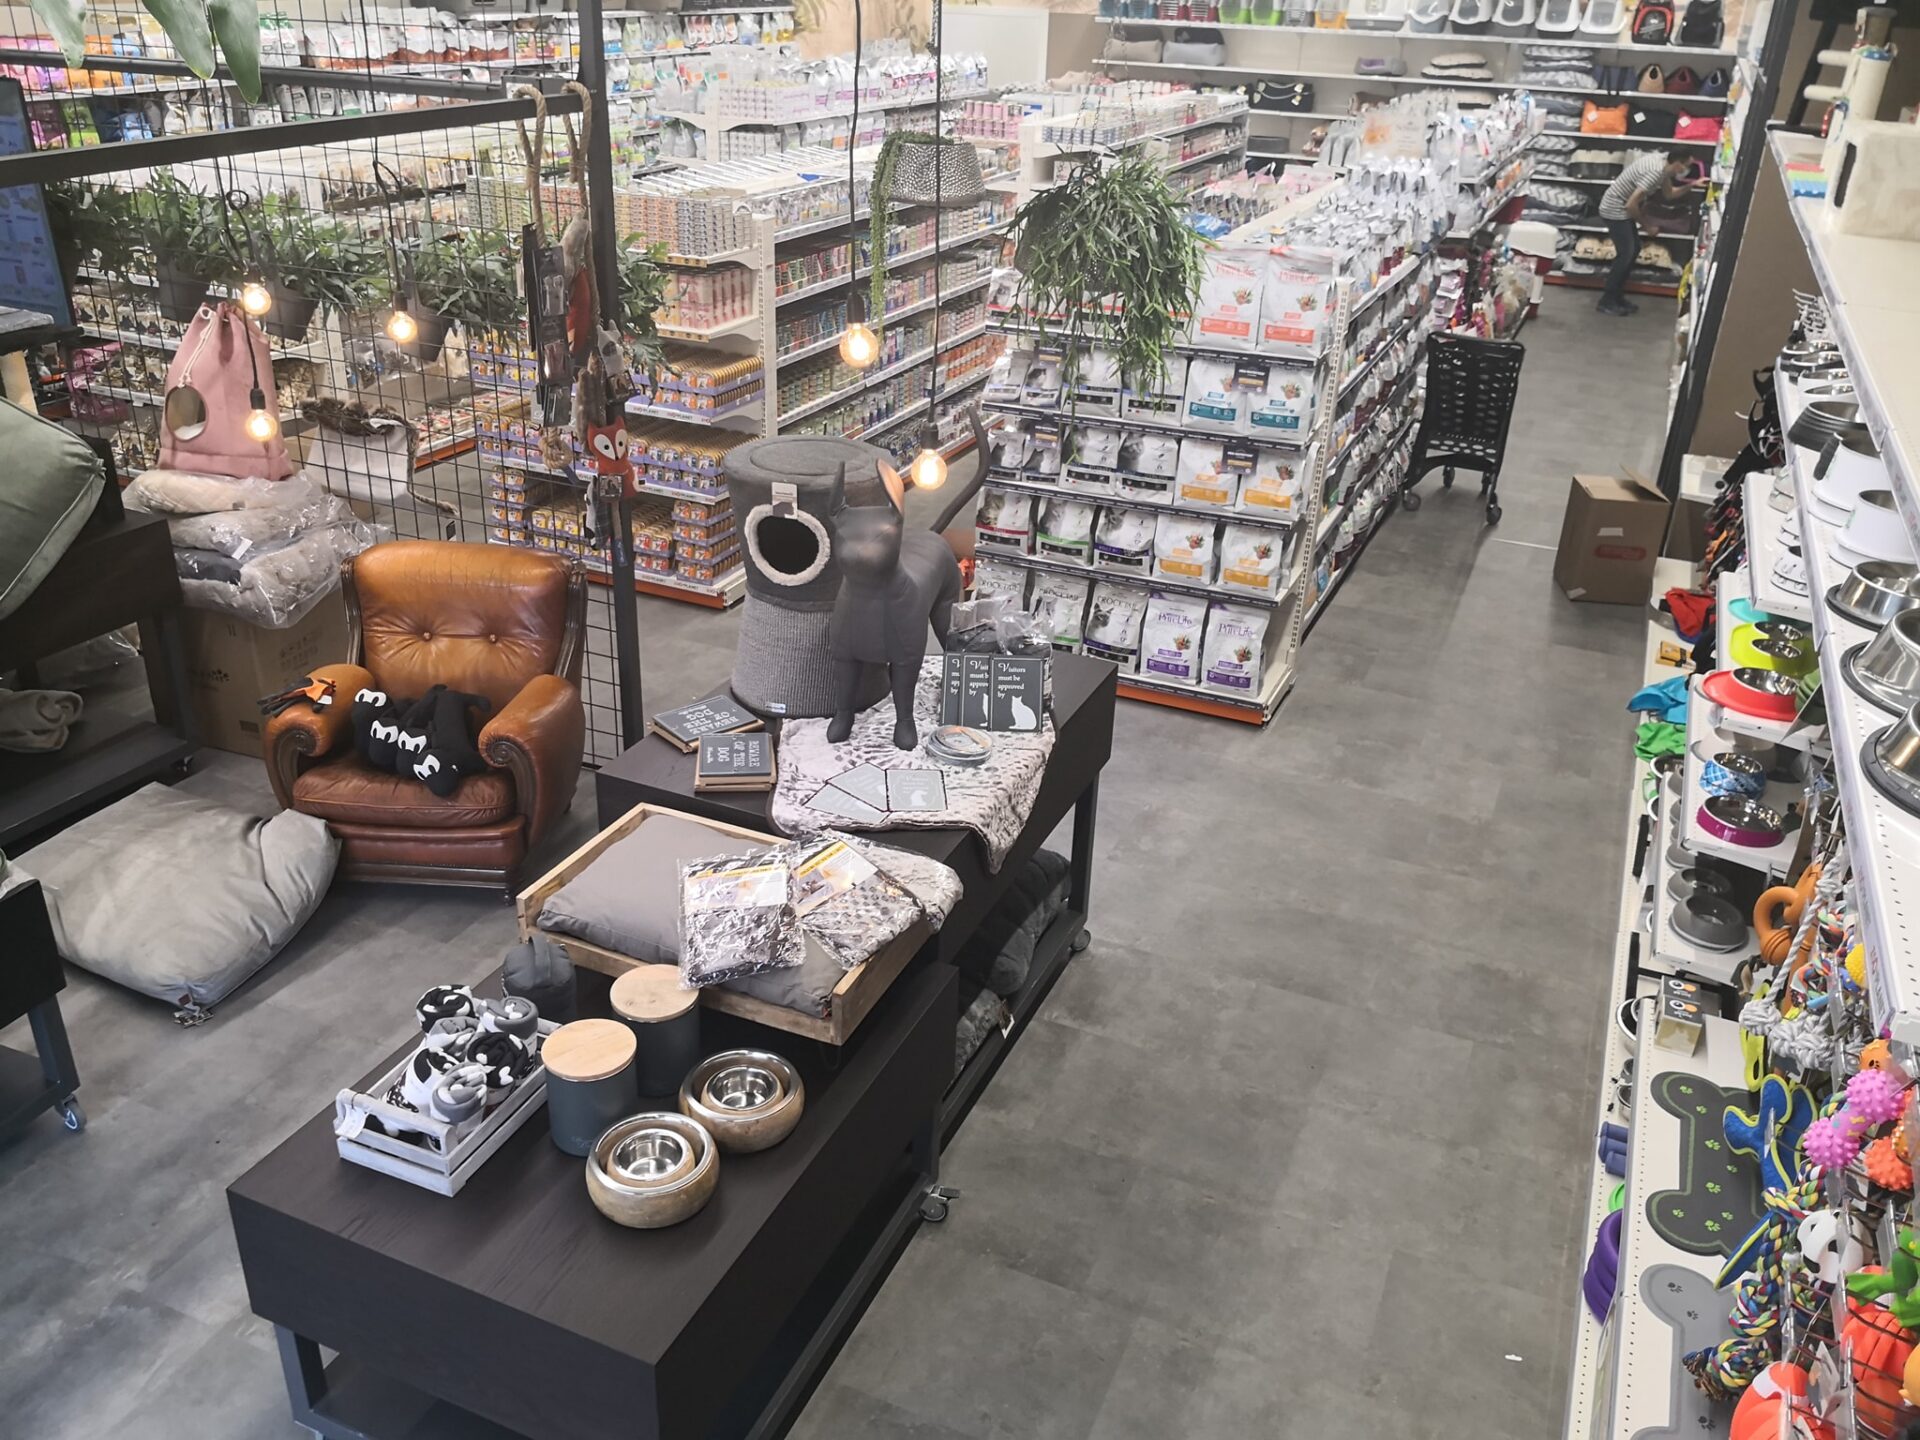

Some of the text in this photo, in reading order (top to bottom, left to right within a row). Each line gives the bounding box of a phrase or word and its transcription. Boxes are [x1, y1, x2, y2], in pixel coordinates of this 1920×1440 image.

[969, 660, 989, 670] Visit
[998, 662, 1026, 673] Visitors
[950, 687, 959, 695] by
[969, 688, 977, 696] by
[997, 683, 1025, 691] approved
[997, 691, 1006, 699] by
[685, 708, 714, 721] DOG
[683, 717, 712, 730] THE
[689, 716, 739, 735] BEWARE
[717, 746, 730, 762] DOG
[748, 740, 760, 768] BEWARE
[733, 753, 746, 768] THE
